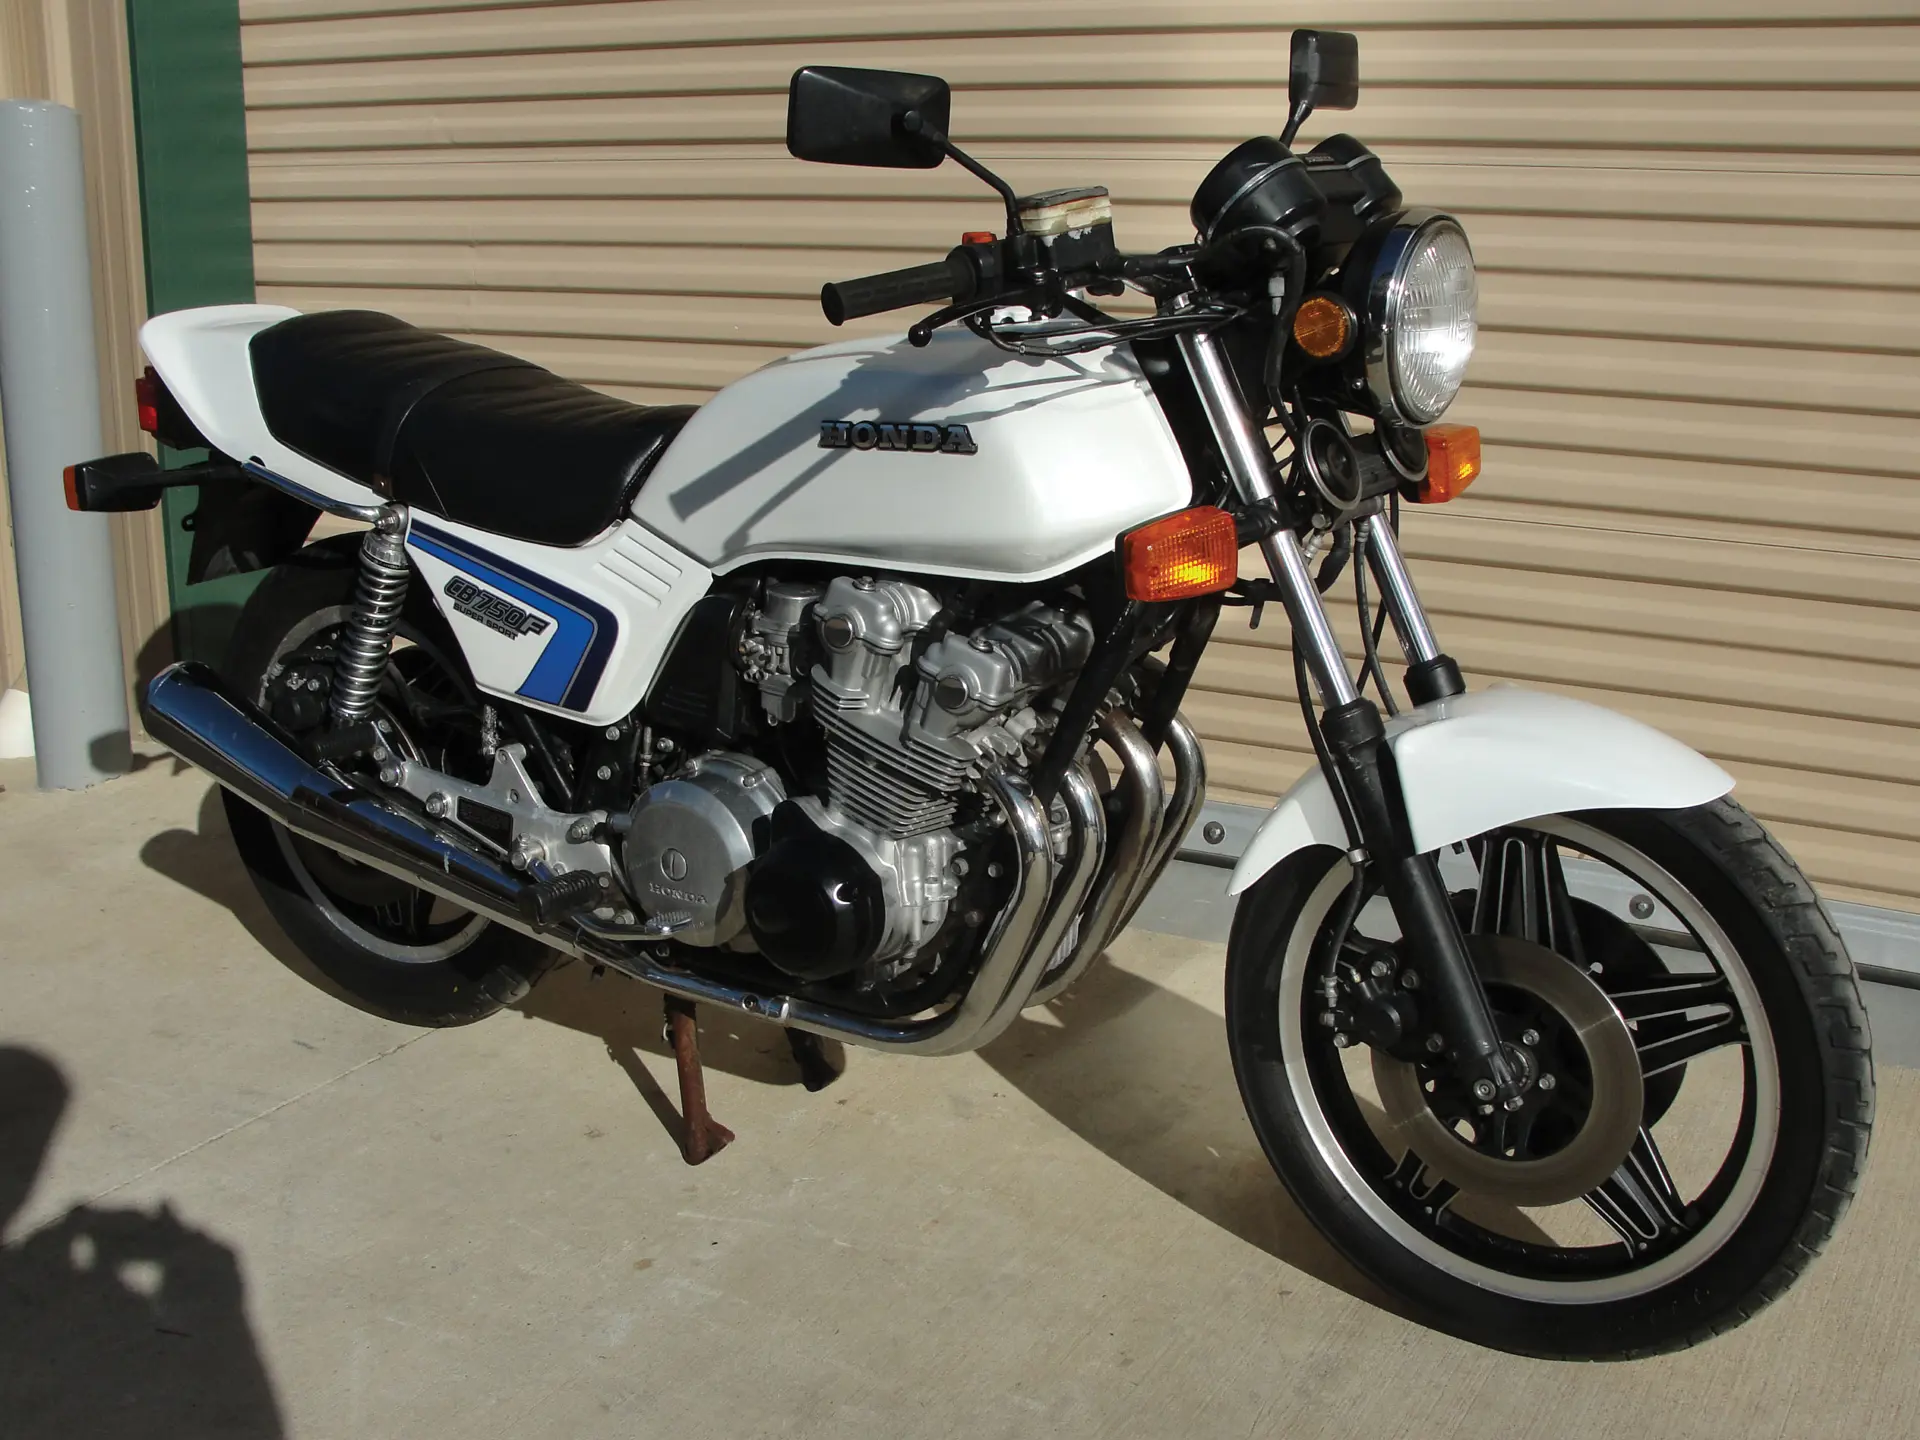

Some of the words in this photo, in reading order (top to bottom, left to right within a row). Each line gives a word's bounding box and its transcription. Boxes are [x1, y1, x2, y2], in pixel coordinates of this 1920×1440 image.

[818, 420, 978, 455] HONDA
[453, 602, 484, 624] SUPER
[486, 619, 518, 641] SPORT
[649, 882, 708, 906] HONDA
